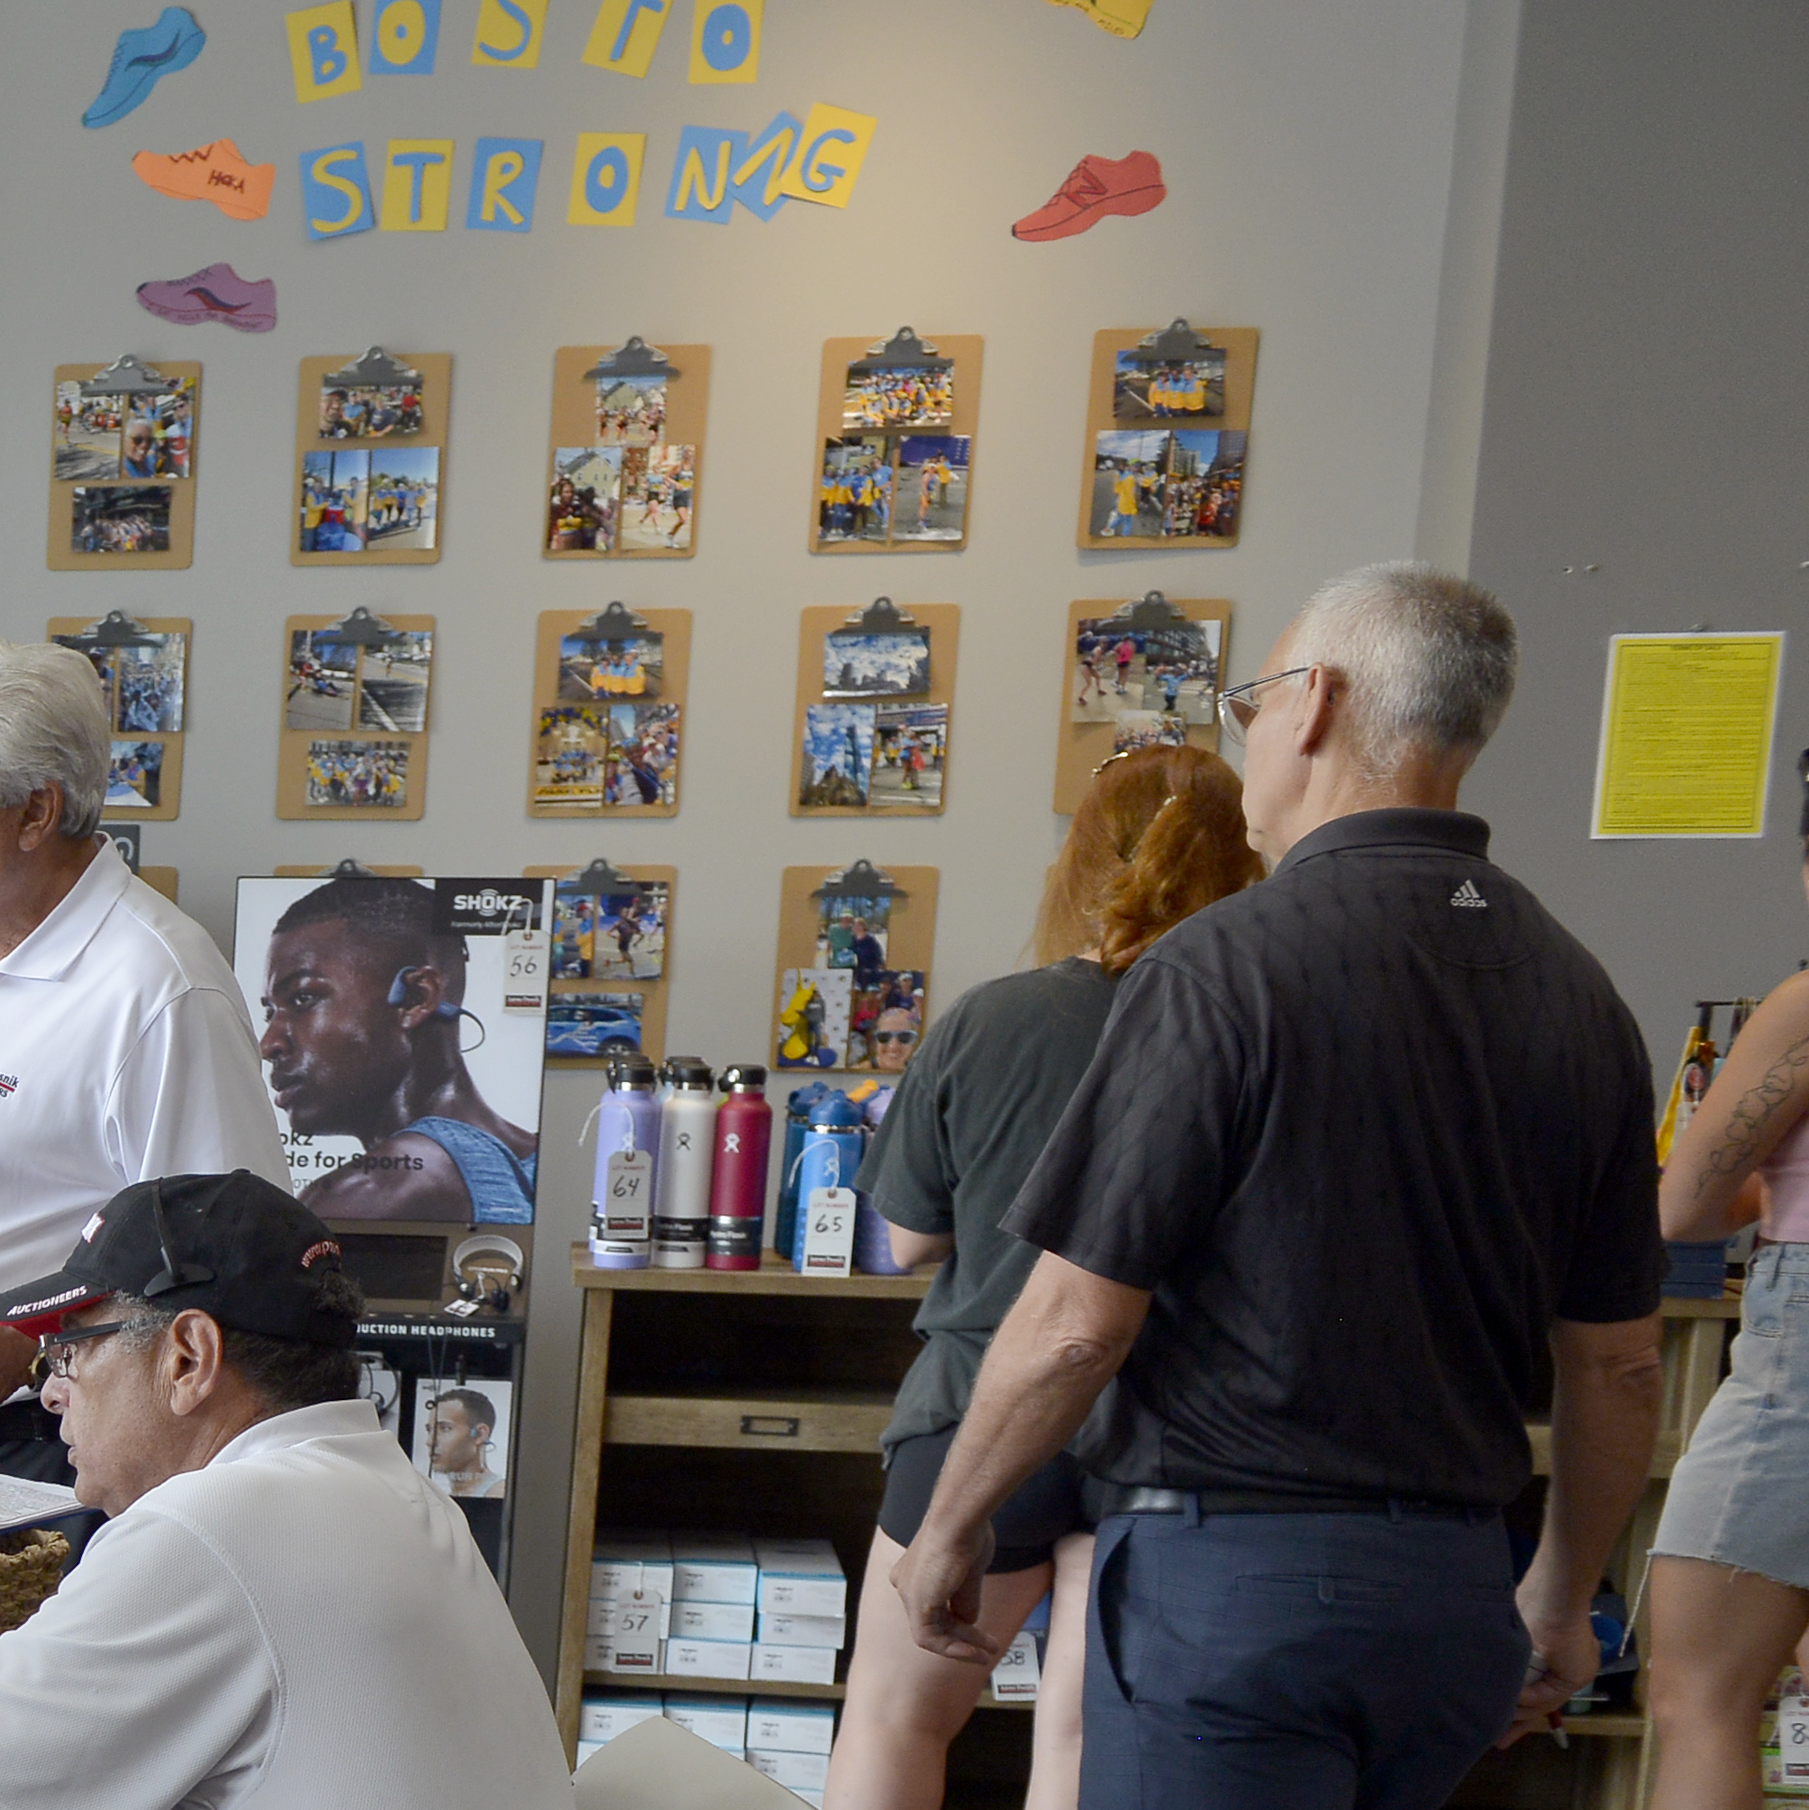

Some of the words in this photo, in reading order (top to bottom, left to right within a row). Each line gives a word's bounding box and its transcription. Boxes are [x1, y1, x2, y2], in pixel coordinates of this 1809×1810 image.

[453, 894, 523, 911] SHOKZ
[1450, 896, 1488, 908] adidas
[509, 954, 538, 977] 56
[314, 1151, 347, 1169] for
[350, 1152, 424, 1175] Sports
[613, 1175, 640, 1198] 64
[815, 1213, 843, 1234] 65
[7, 1285, 88, 1317] AUCTIONEERS
[410, 1325, 496, 1338] HEADPHONES
[621, 1613, 649, 1632] 57
